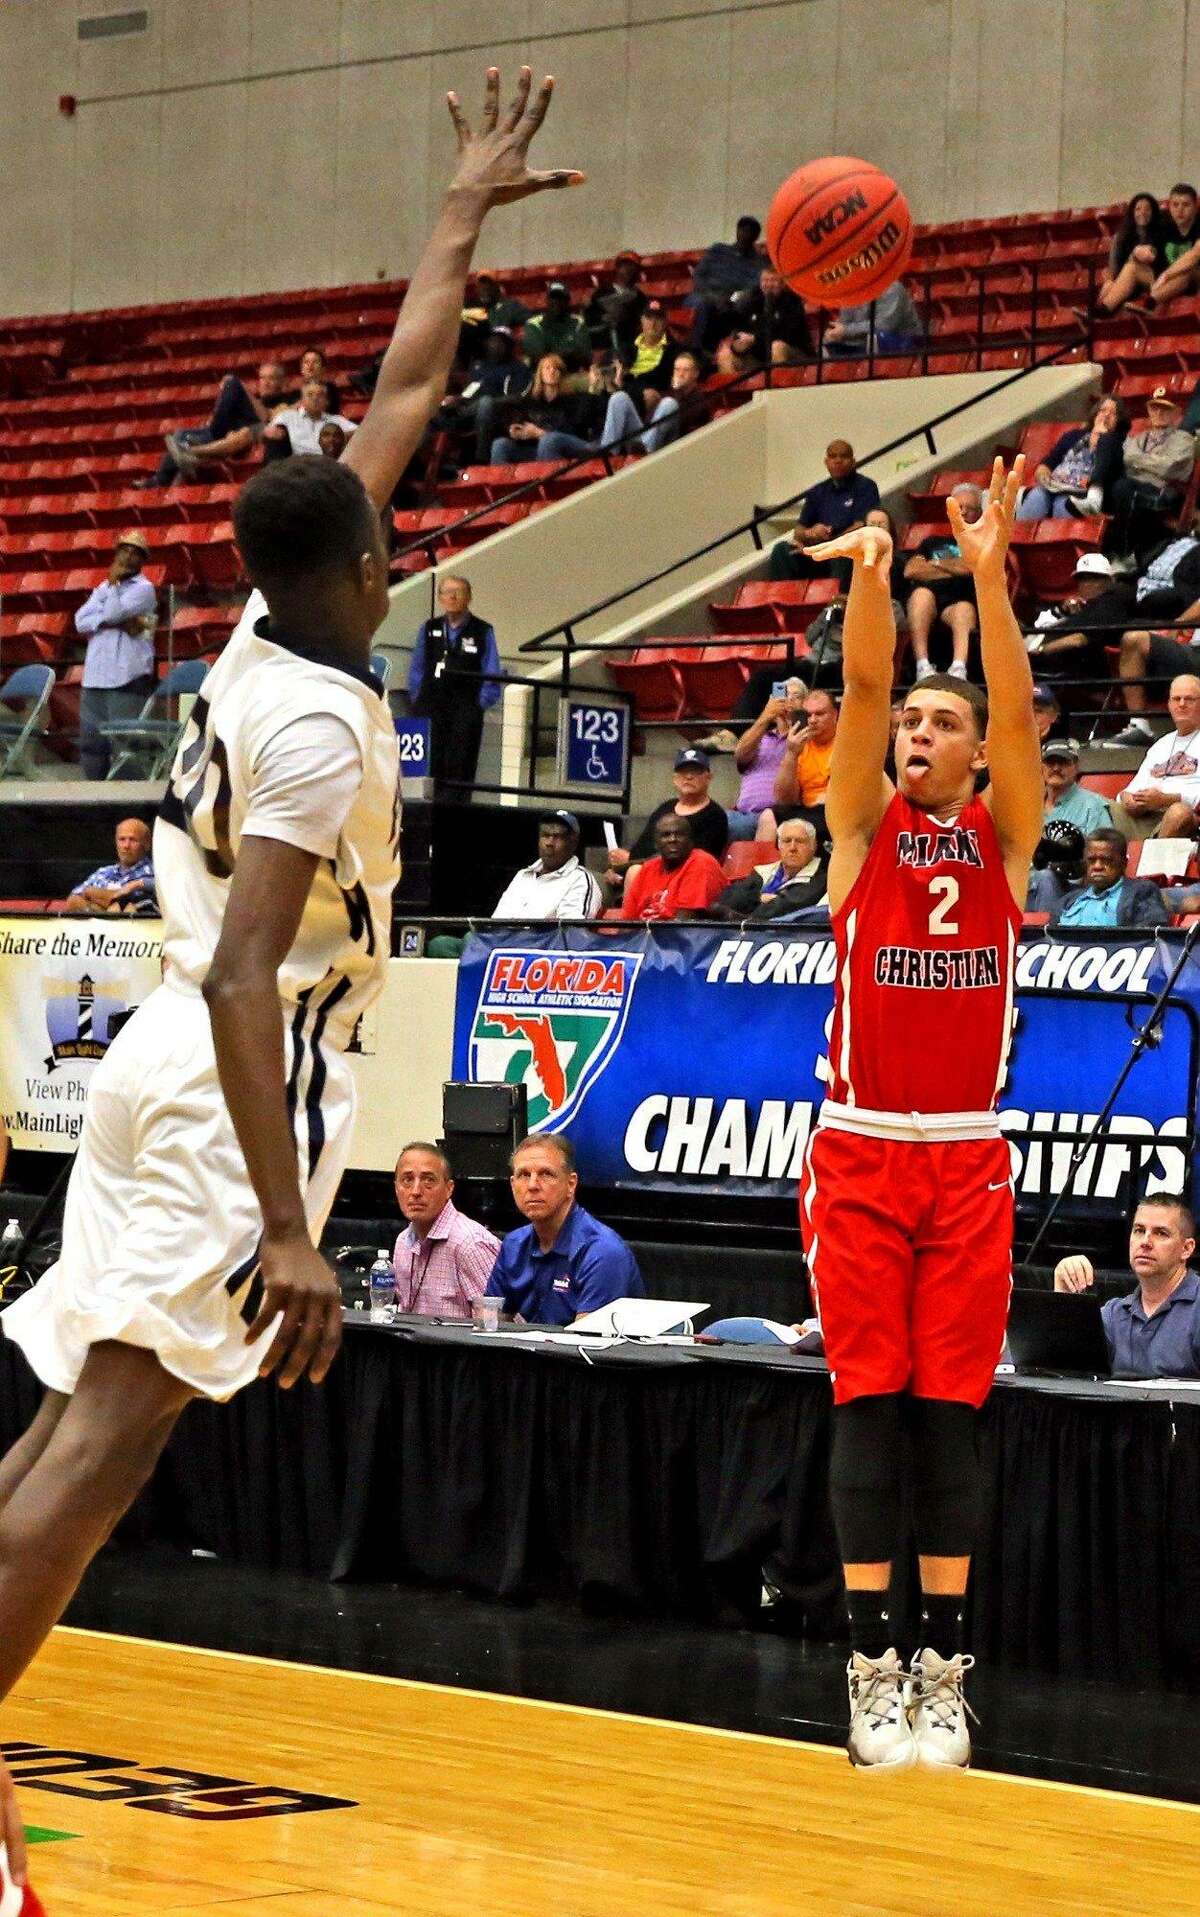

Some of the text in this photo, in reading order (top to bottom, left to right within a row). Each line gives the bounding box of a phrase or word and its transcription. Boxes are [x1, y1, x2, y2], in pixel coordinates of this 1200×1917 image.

[805, 189, 867, 245] NCAA
[572, 708, 619, 744] 123
[928, 875, 959, 936] 2
[51, 932, 81, 957] the
[490, 957, 625, 995] FLORIDA
[874, 945, 1001, 990] CHRISTIAN
[26, 1078, 88, 1101] View Ph
